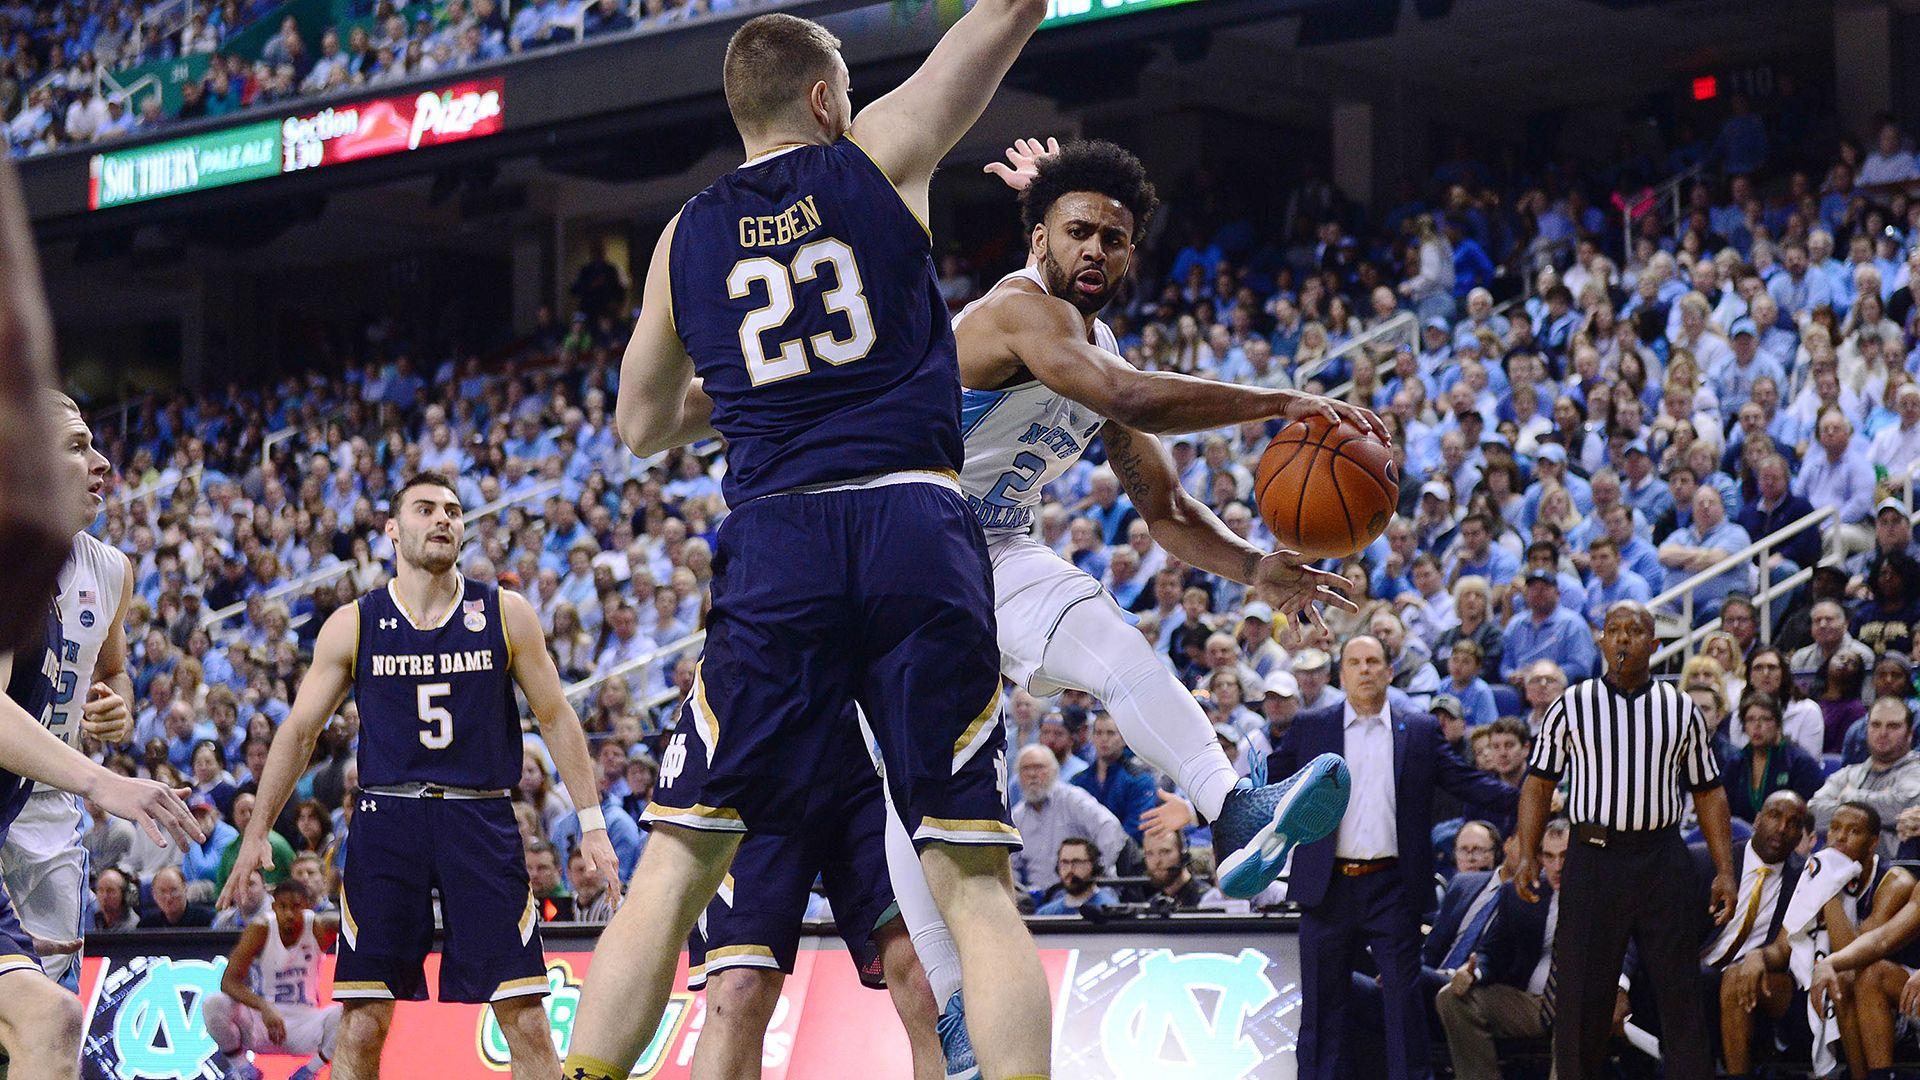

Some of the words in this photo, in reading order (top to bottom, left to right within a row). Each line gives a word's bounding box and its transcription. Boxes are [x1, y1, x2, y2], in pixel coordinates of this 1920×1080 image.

[738, 194, 823, 248] GEBEN
[725, 236, 877, 388] 23
[982, 451, 1047, 508] 2
[372, 655, 435, 676] NOTRE
[439, 650, 493, 674] DAME
[417, 682, 454, 750] 5
[275, 981, 306, 1005] 21
